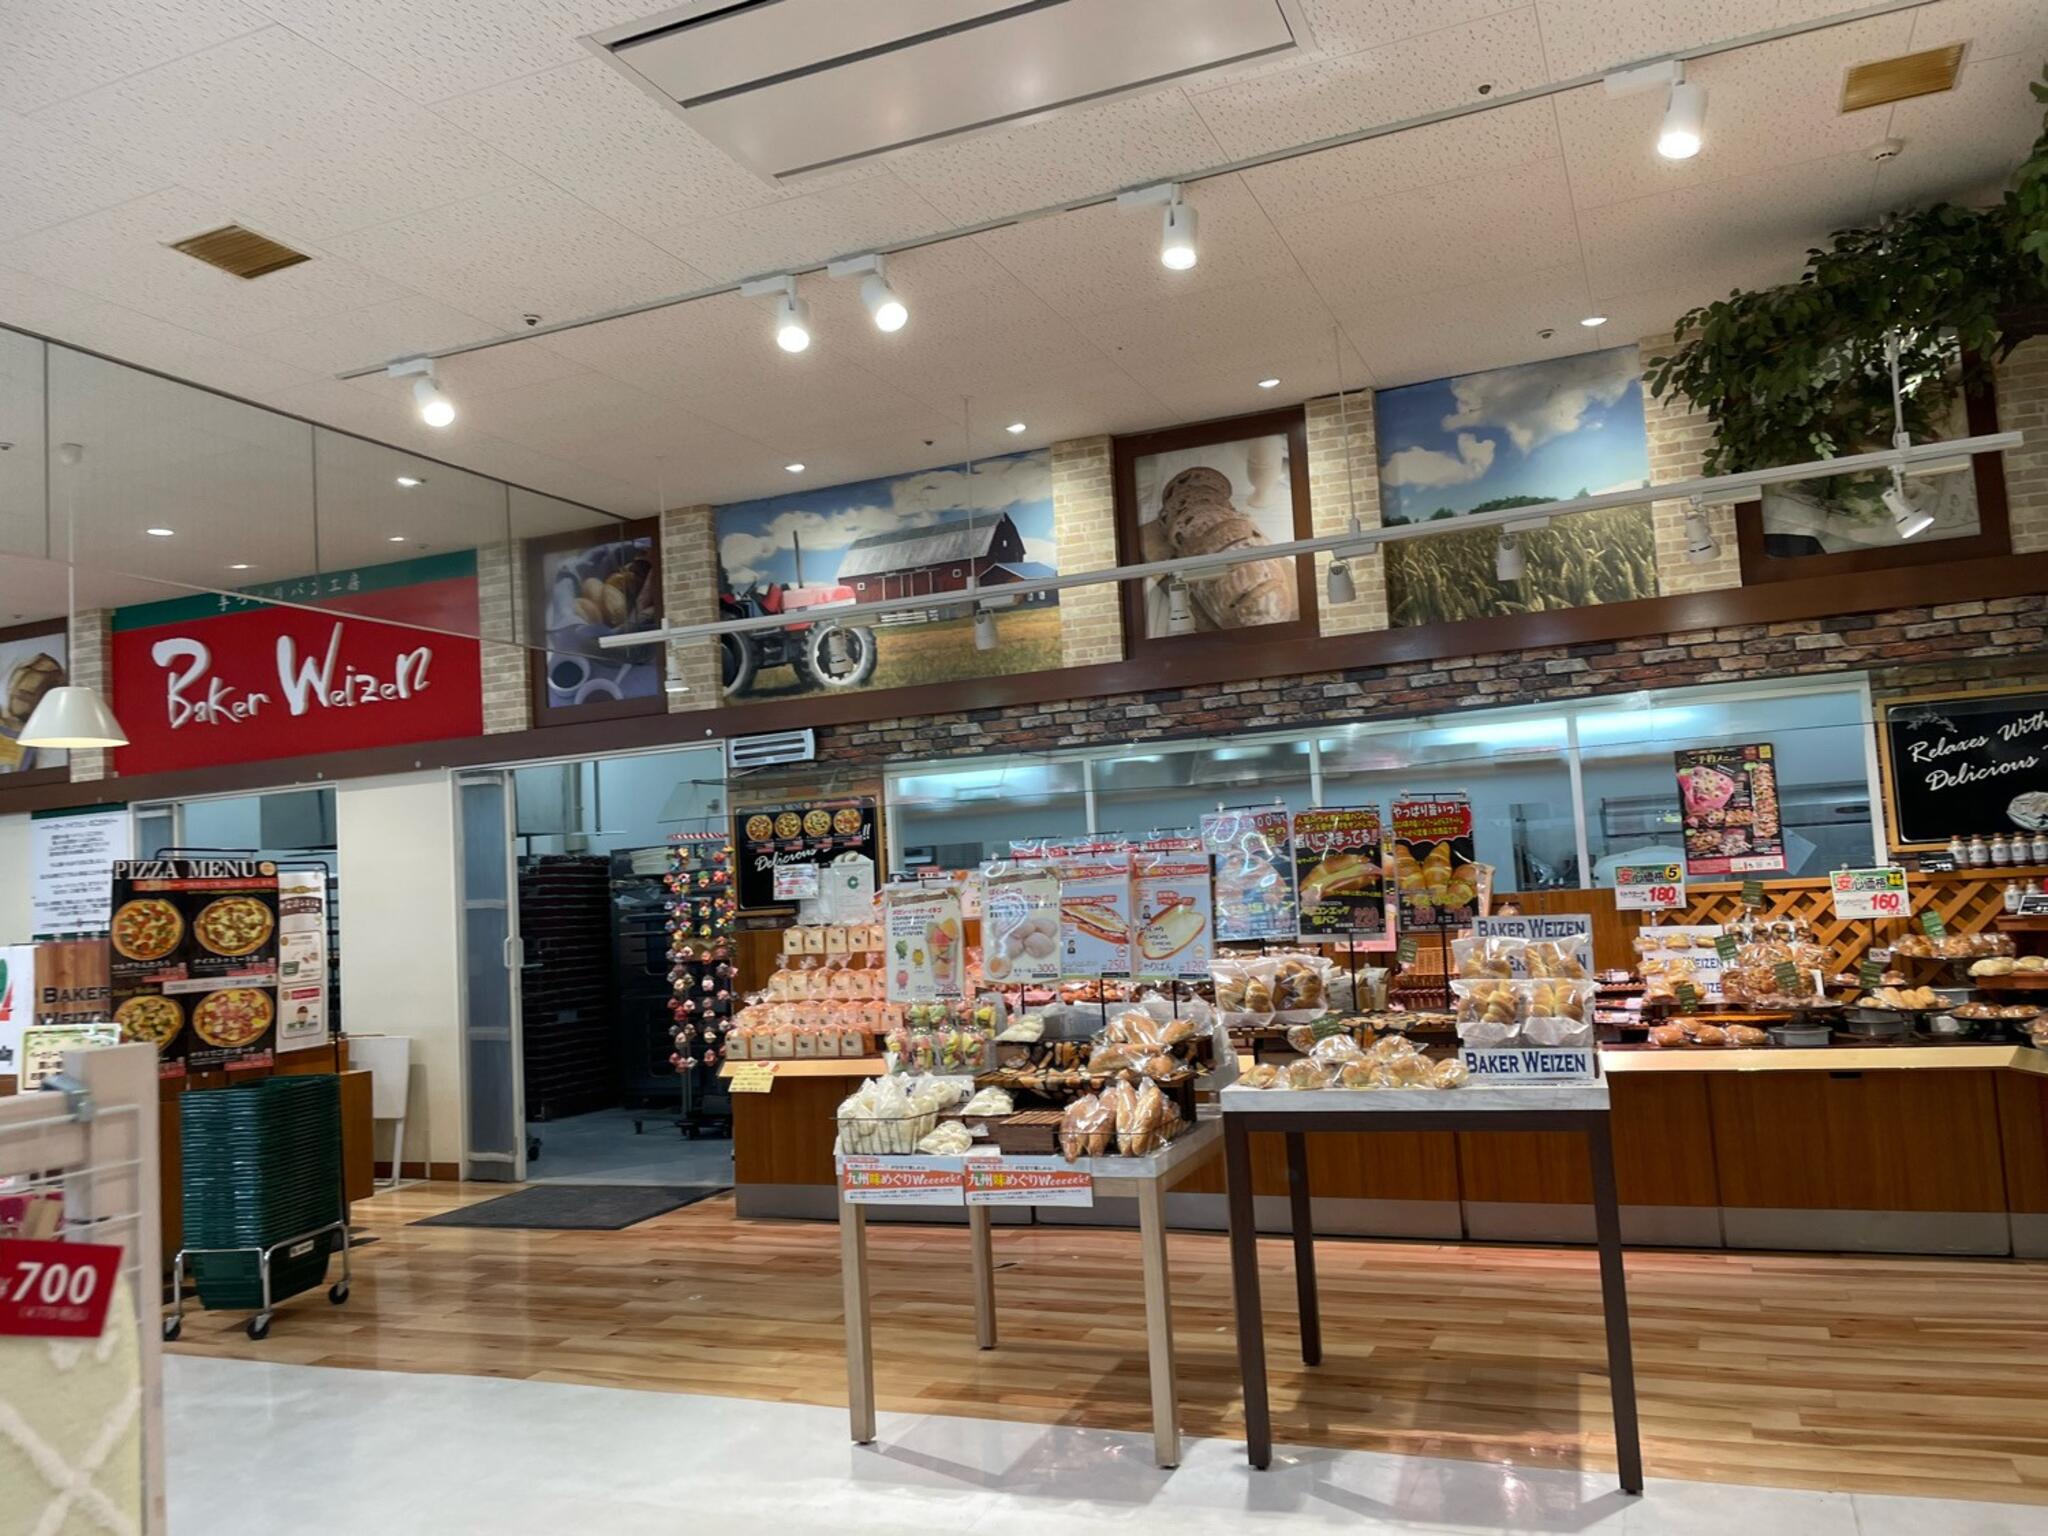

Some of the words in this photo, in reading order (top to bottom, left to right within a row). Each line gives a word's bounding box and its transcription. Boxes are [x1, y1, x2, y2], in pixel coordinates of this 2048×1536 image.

[151, 637, 271, 729] Baker
[276, 622, 433, 716] Weizen
[1907, 736, 1990, 763] Relaxes
[1997, 711, 2048, 742] With
[1925, 762, 2039, 791] Delicious
[754, 847, 818, 872] Delicious
[114, 860, 181, 880] PIZZA
[187, 860, 257, 879] MENU
[1667, 867, 1677, 879] 5
[1649, 886, 1677, 903] 180
[1871, 892, 1900, 911] 160
[1477, 920, 1526, 938] BAKER
[1528, 918, 1586, 938] WEIZEN
[43, 986, 112, 1003] BAKER
[1465, 1052, 1518, 1074] BAKER
[1522, 1051, 1586, 1073] WEIZEN
